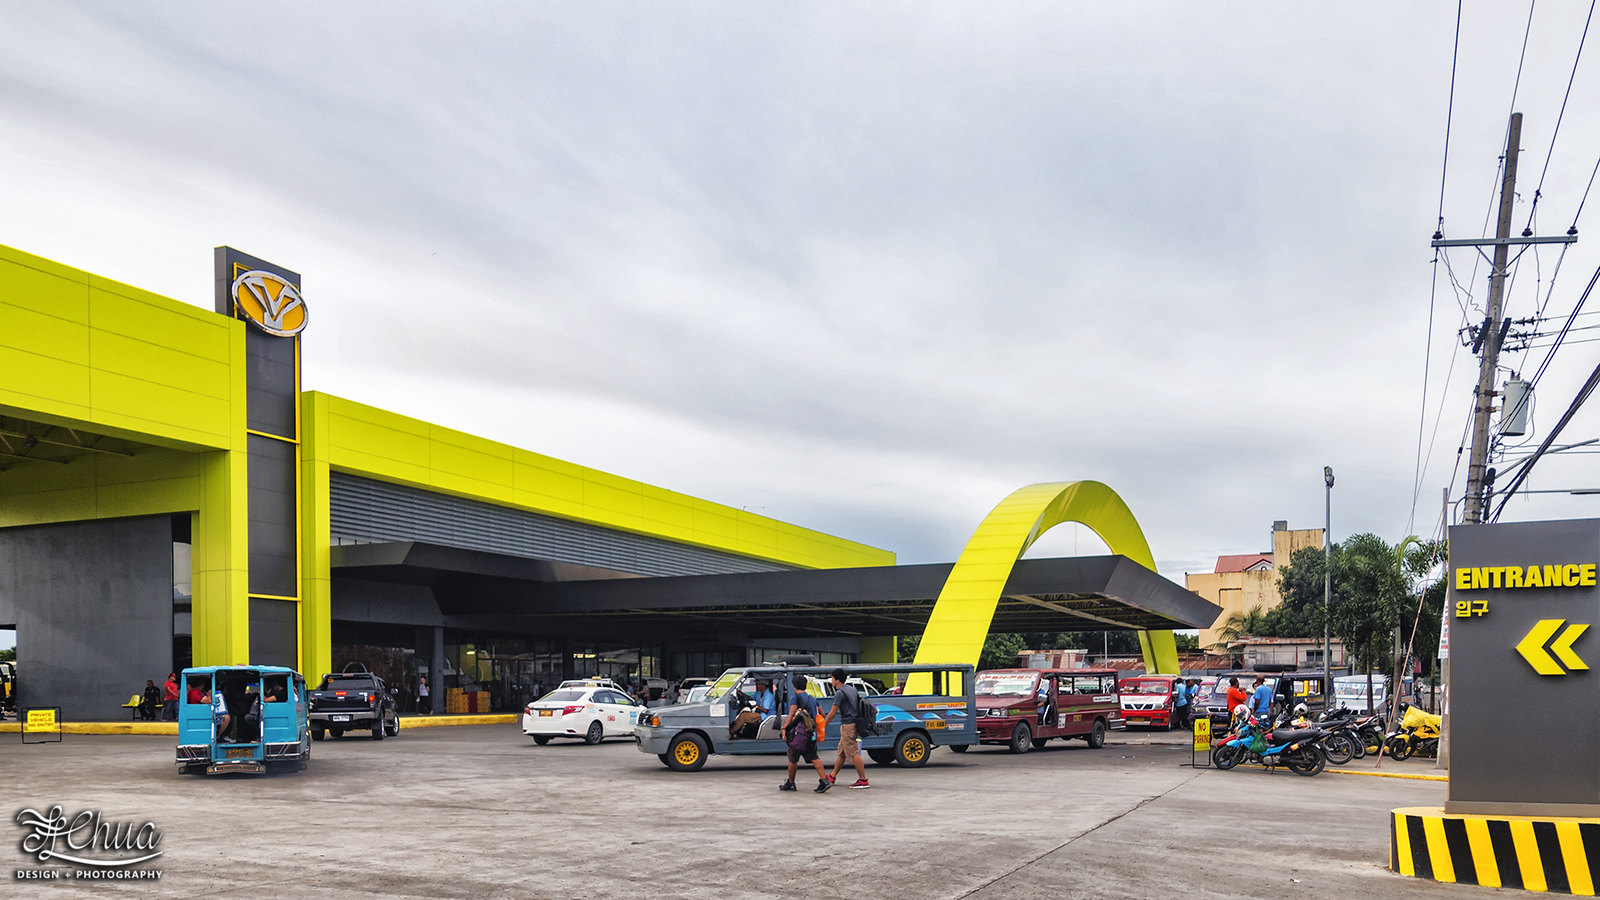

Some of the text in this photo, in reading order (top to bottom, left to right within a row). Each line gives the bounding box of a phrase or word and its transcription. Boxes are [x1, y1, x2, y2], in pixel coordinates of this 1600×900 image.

[1455, 563, 1597, 590] ENTRANCE
[1455, 600, 1489, 618] 입구
[1198, 722, 1206, 732] NO
[1194, 734, 1210, 744] PARKING
